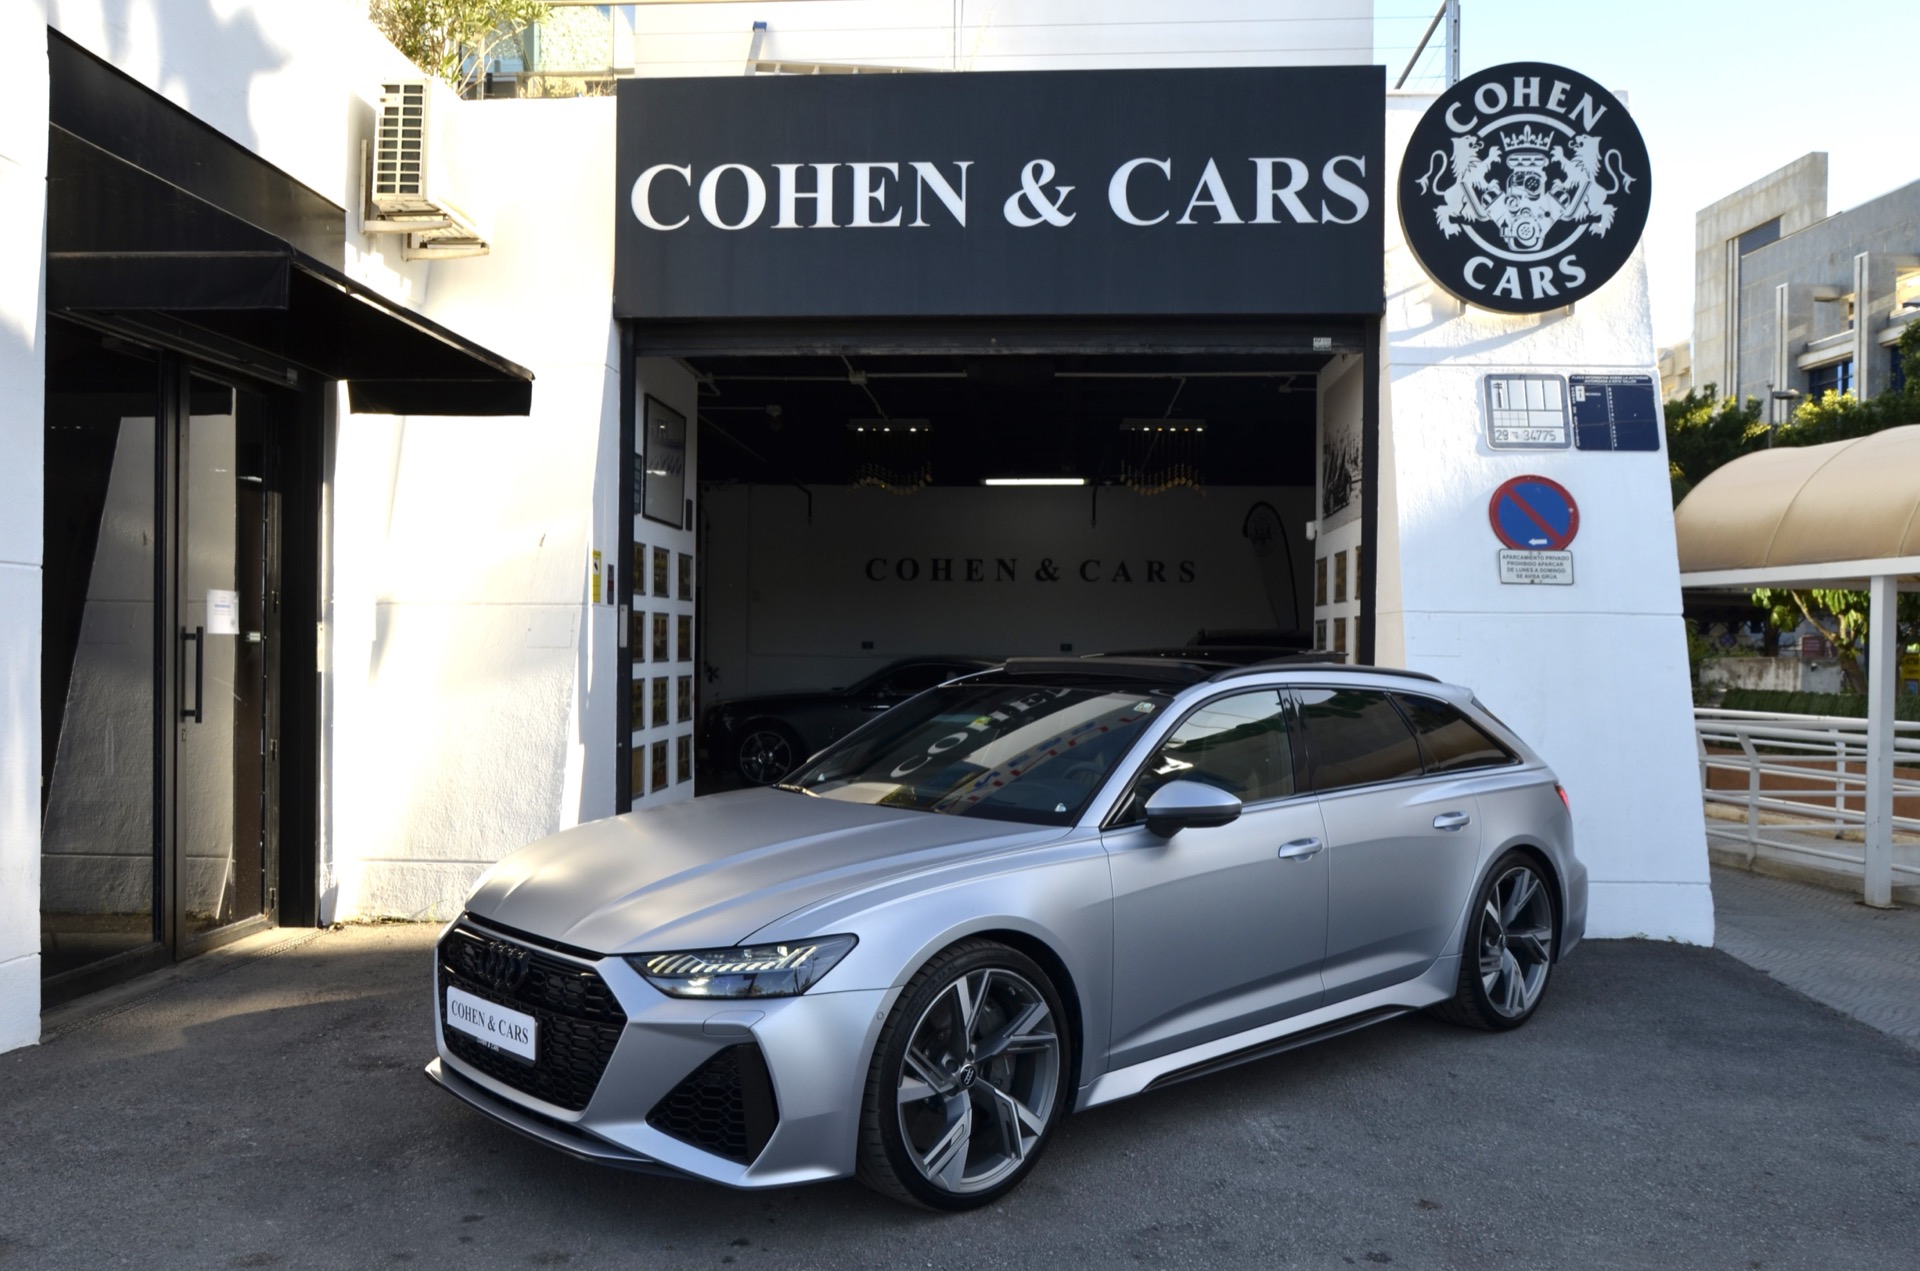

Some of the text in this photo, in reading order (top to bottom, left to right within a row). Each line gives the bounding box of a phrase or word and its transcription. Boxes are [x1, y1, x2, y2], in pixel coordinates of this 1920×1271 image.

[1445, 76, 1608, 134] COHEN
[631, 155, 1369, 231] COHEN & CARS
[1463, 254, 1587, 300] CARS
[1495, 429, 1509, 441] 29
[1523, 429, 1557, 441] 34775
[865, 557, 1196, 583] COHEN & CARS
[451, 1000, 529, 1045] COHEN & CARS
